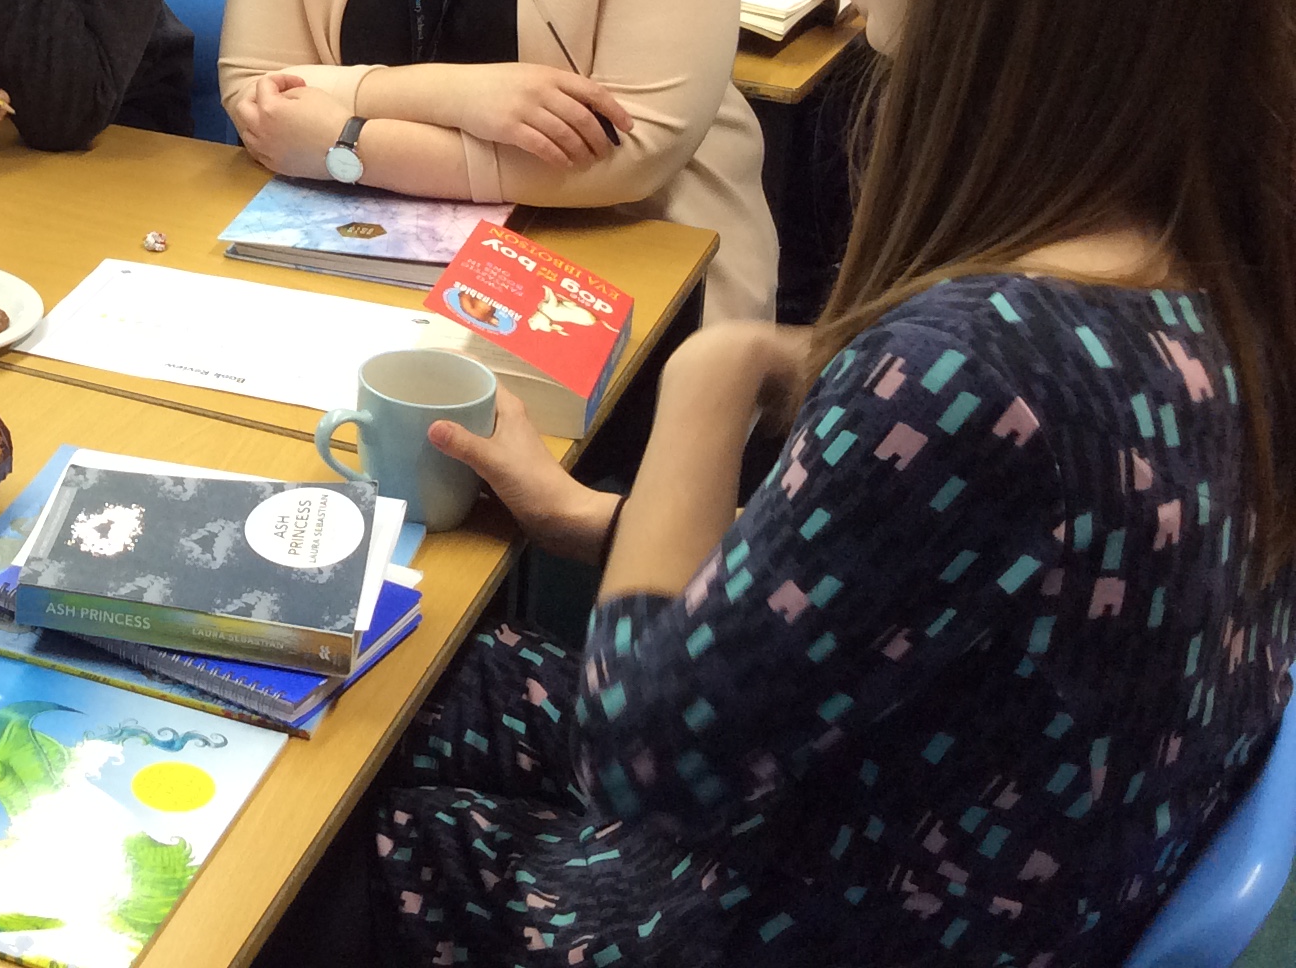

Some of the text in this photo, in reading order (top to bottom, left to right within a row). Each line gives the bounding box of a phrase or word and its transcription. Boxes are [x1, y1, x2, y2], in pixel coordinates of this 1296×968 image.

[481, 238, 614, 314] dog boy
[488, 228, 621, 301] EVA IBBOTSON
[453, 281, 523, 322] Abominables
[273, 515, 291, 539] ASH
[288, 499, 312, 556] PRINCESS
[309, 494, 329, 564] LAURA SEBASTIAN
[45, 601, 152, 631] ASH PRINCESS
[191, 627, 285, 650] LAURA SEBASTIAN
